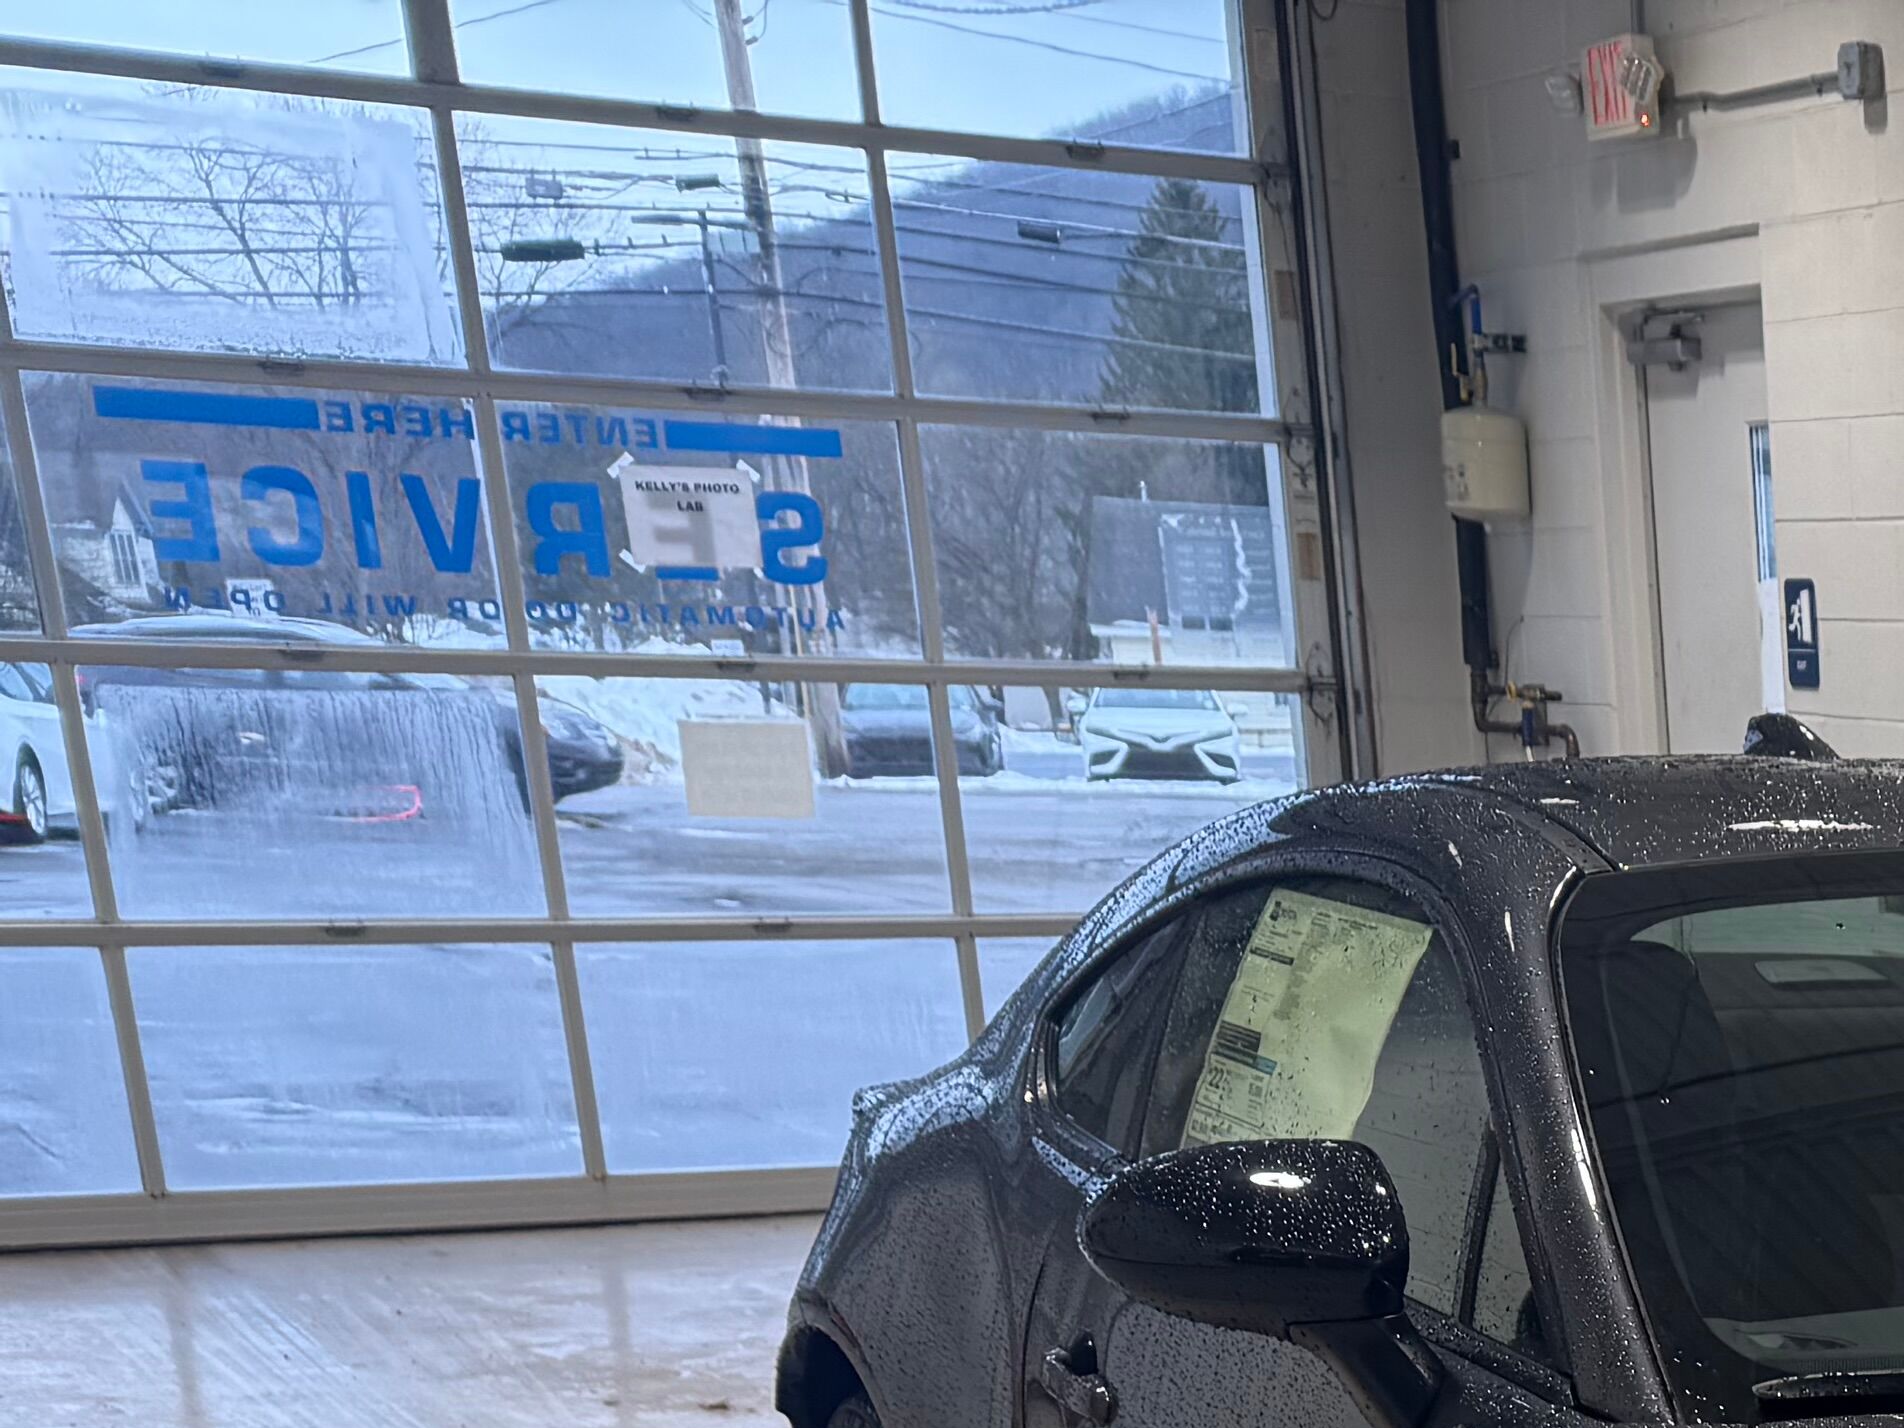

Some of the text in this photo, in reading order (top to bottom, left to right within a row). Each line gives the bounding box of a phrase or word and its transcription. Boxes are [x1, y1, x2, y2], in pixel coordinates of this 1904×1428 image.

[635, 481, 740, 495] KELLY'S PHOTO
[677, 500, 704, 512] LAB
